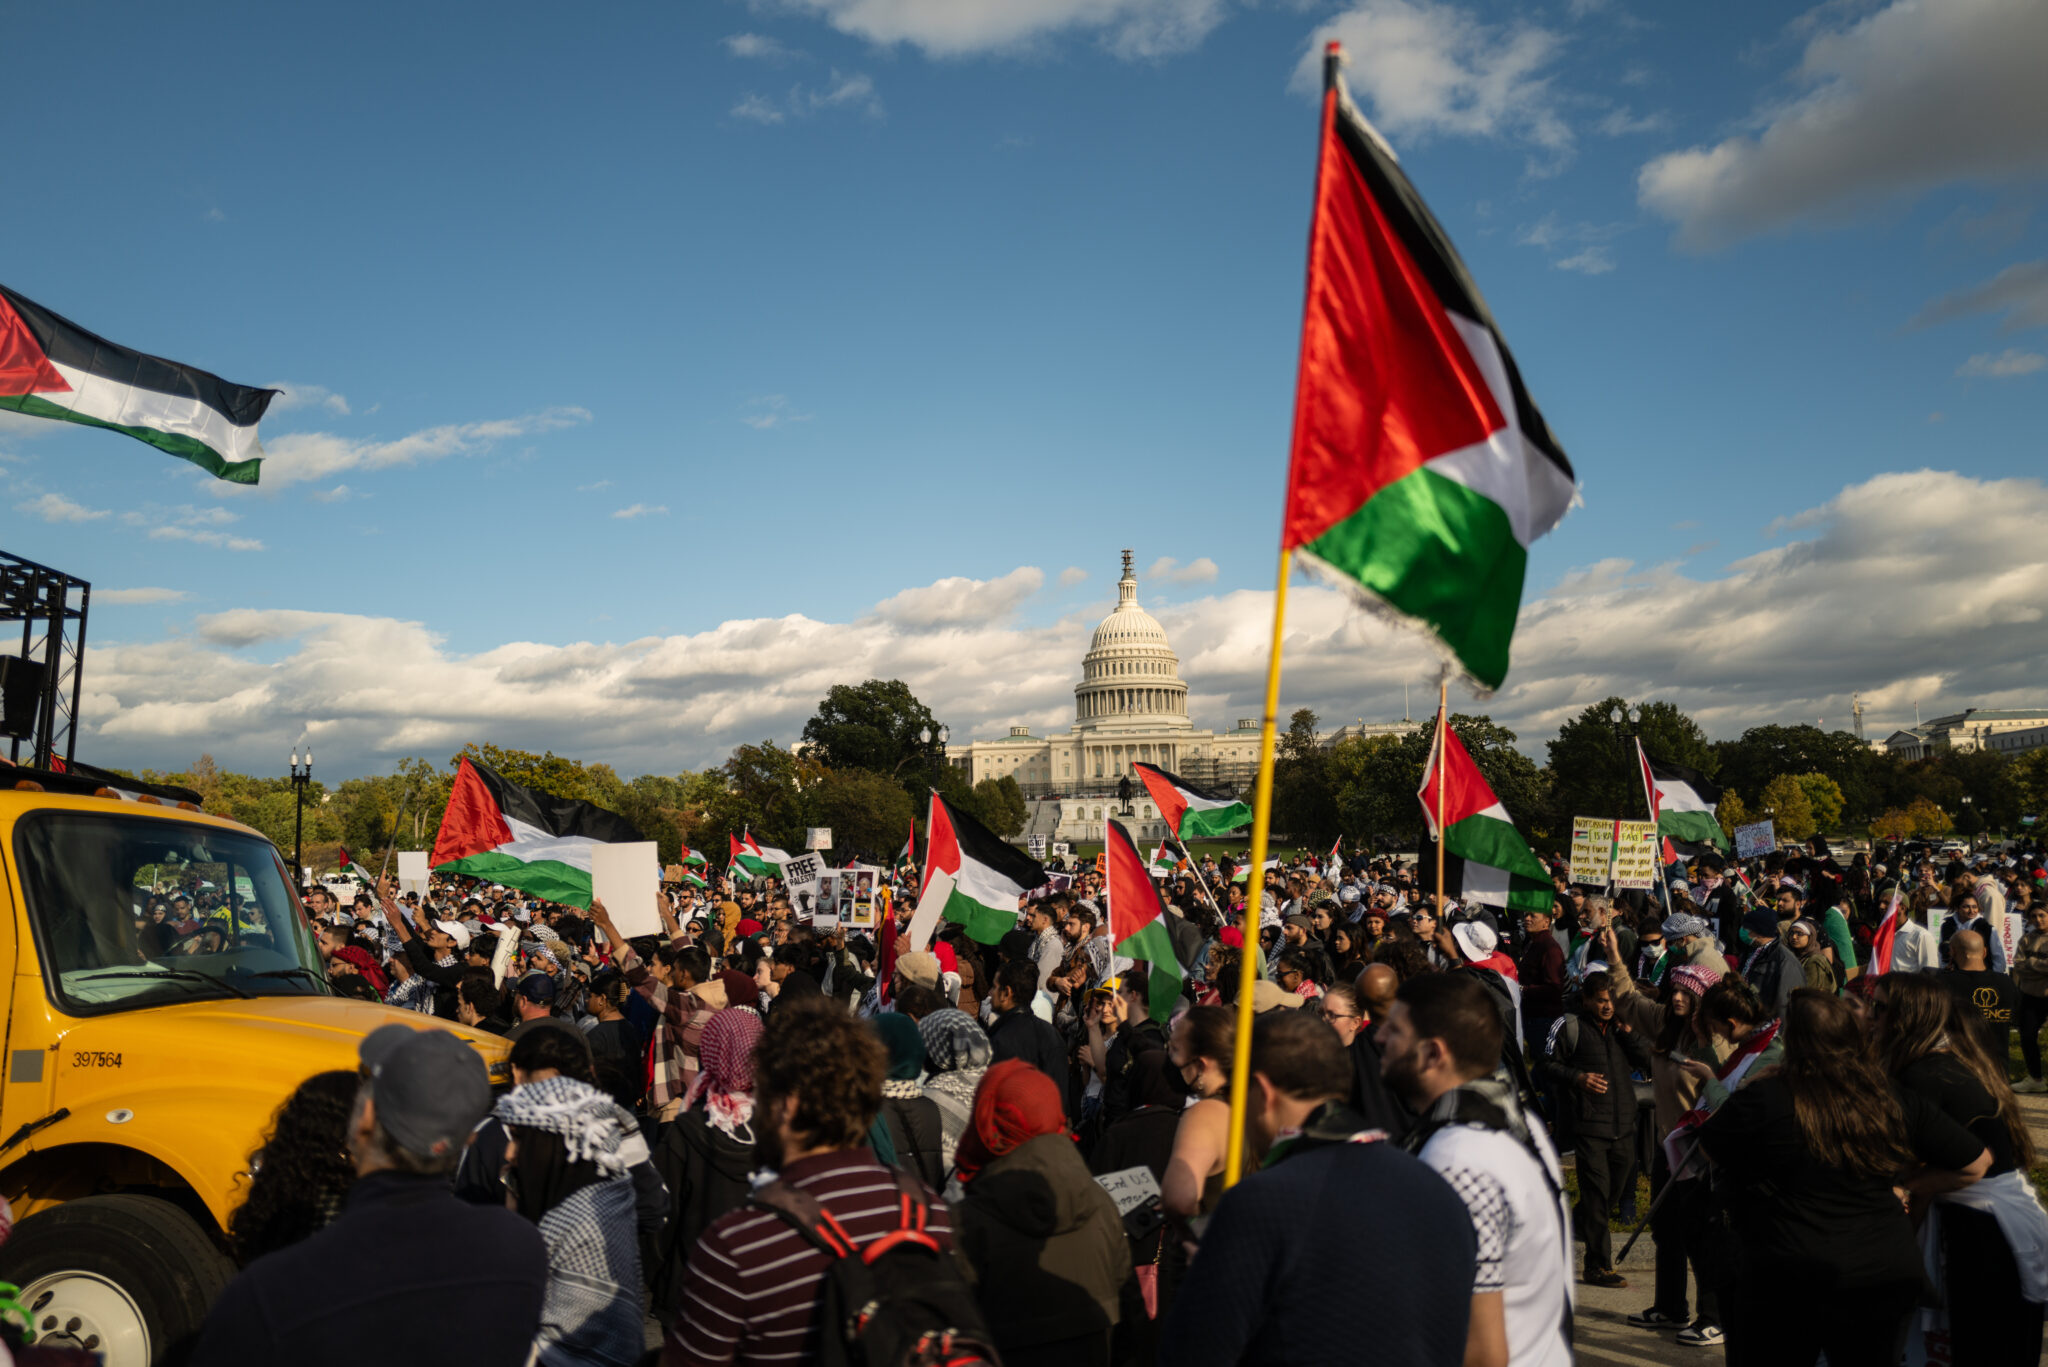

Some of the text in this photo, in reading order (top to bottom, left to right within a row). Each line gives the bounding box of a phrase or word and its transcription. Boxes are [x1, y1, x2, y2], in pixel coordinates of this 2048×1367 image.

[786, 857, 817, 878] FREE
[788, 871, 816, 887] PALESTIN
[72, 1051, 123, 1068] 397564
